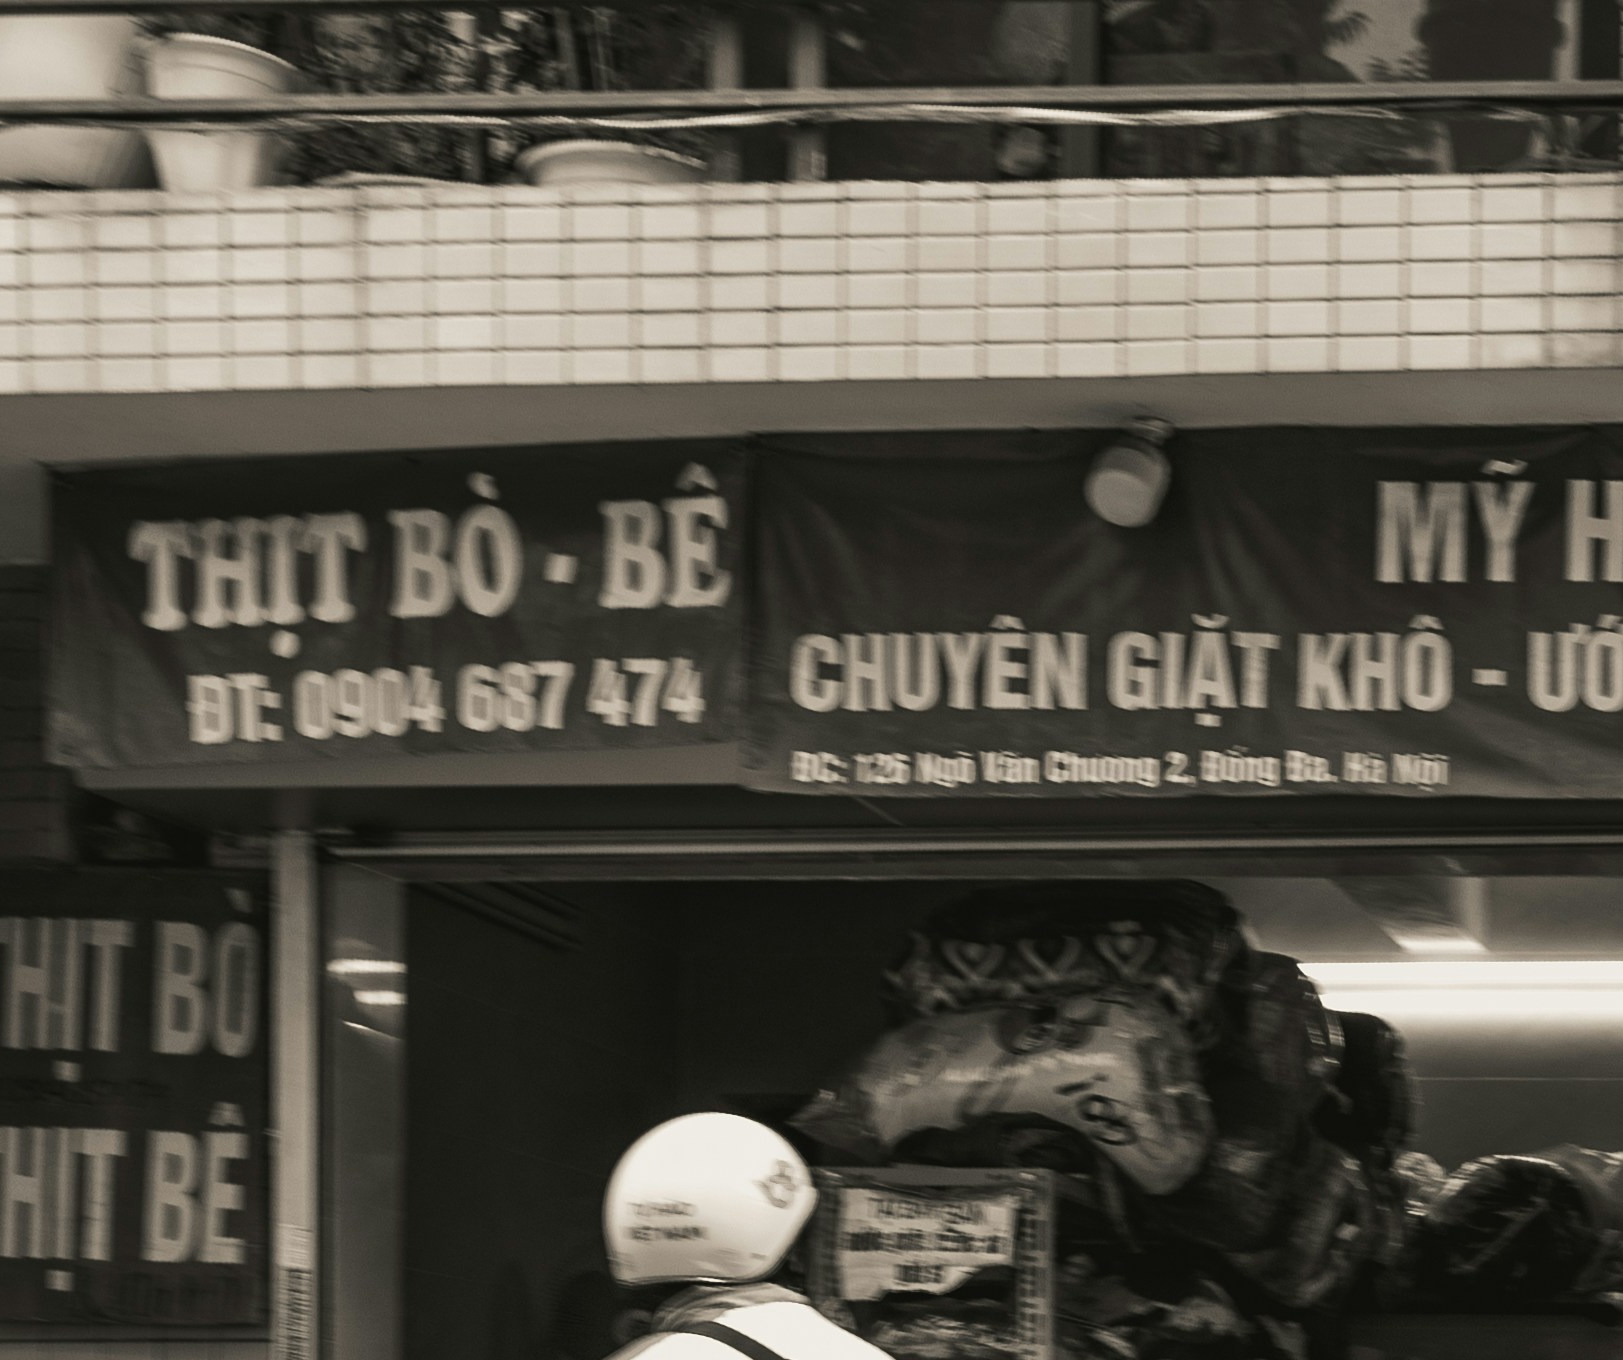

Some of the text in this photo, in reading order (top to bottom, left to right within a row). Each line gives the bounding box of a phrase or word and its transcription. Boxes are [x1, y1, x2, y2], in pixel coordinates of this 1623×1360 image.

[128, 461, 731, 658] THỊT BÒ - BÊ
[1376, 459, 1535, 583] MỸ
[187, 657, 705, 745] ĐT: 0904 687 474
[789, 614, 1090, 712] CHUYÊN
[1105, 613, 1281, 727] GIẶT
[1297, 614, 1454, 712] KHÔ
[1471, 668, 1508, 687] -
[1199, 745, 1282, 788] Đống
[1342, 751, 1388, 784] Hà
[1390, 752, 1450, 793] Nội
[150, 888, 261, 1058] BÒ
[139, 1101, 251, 1265] BÊ
